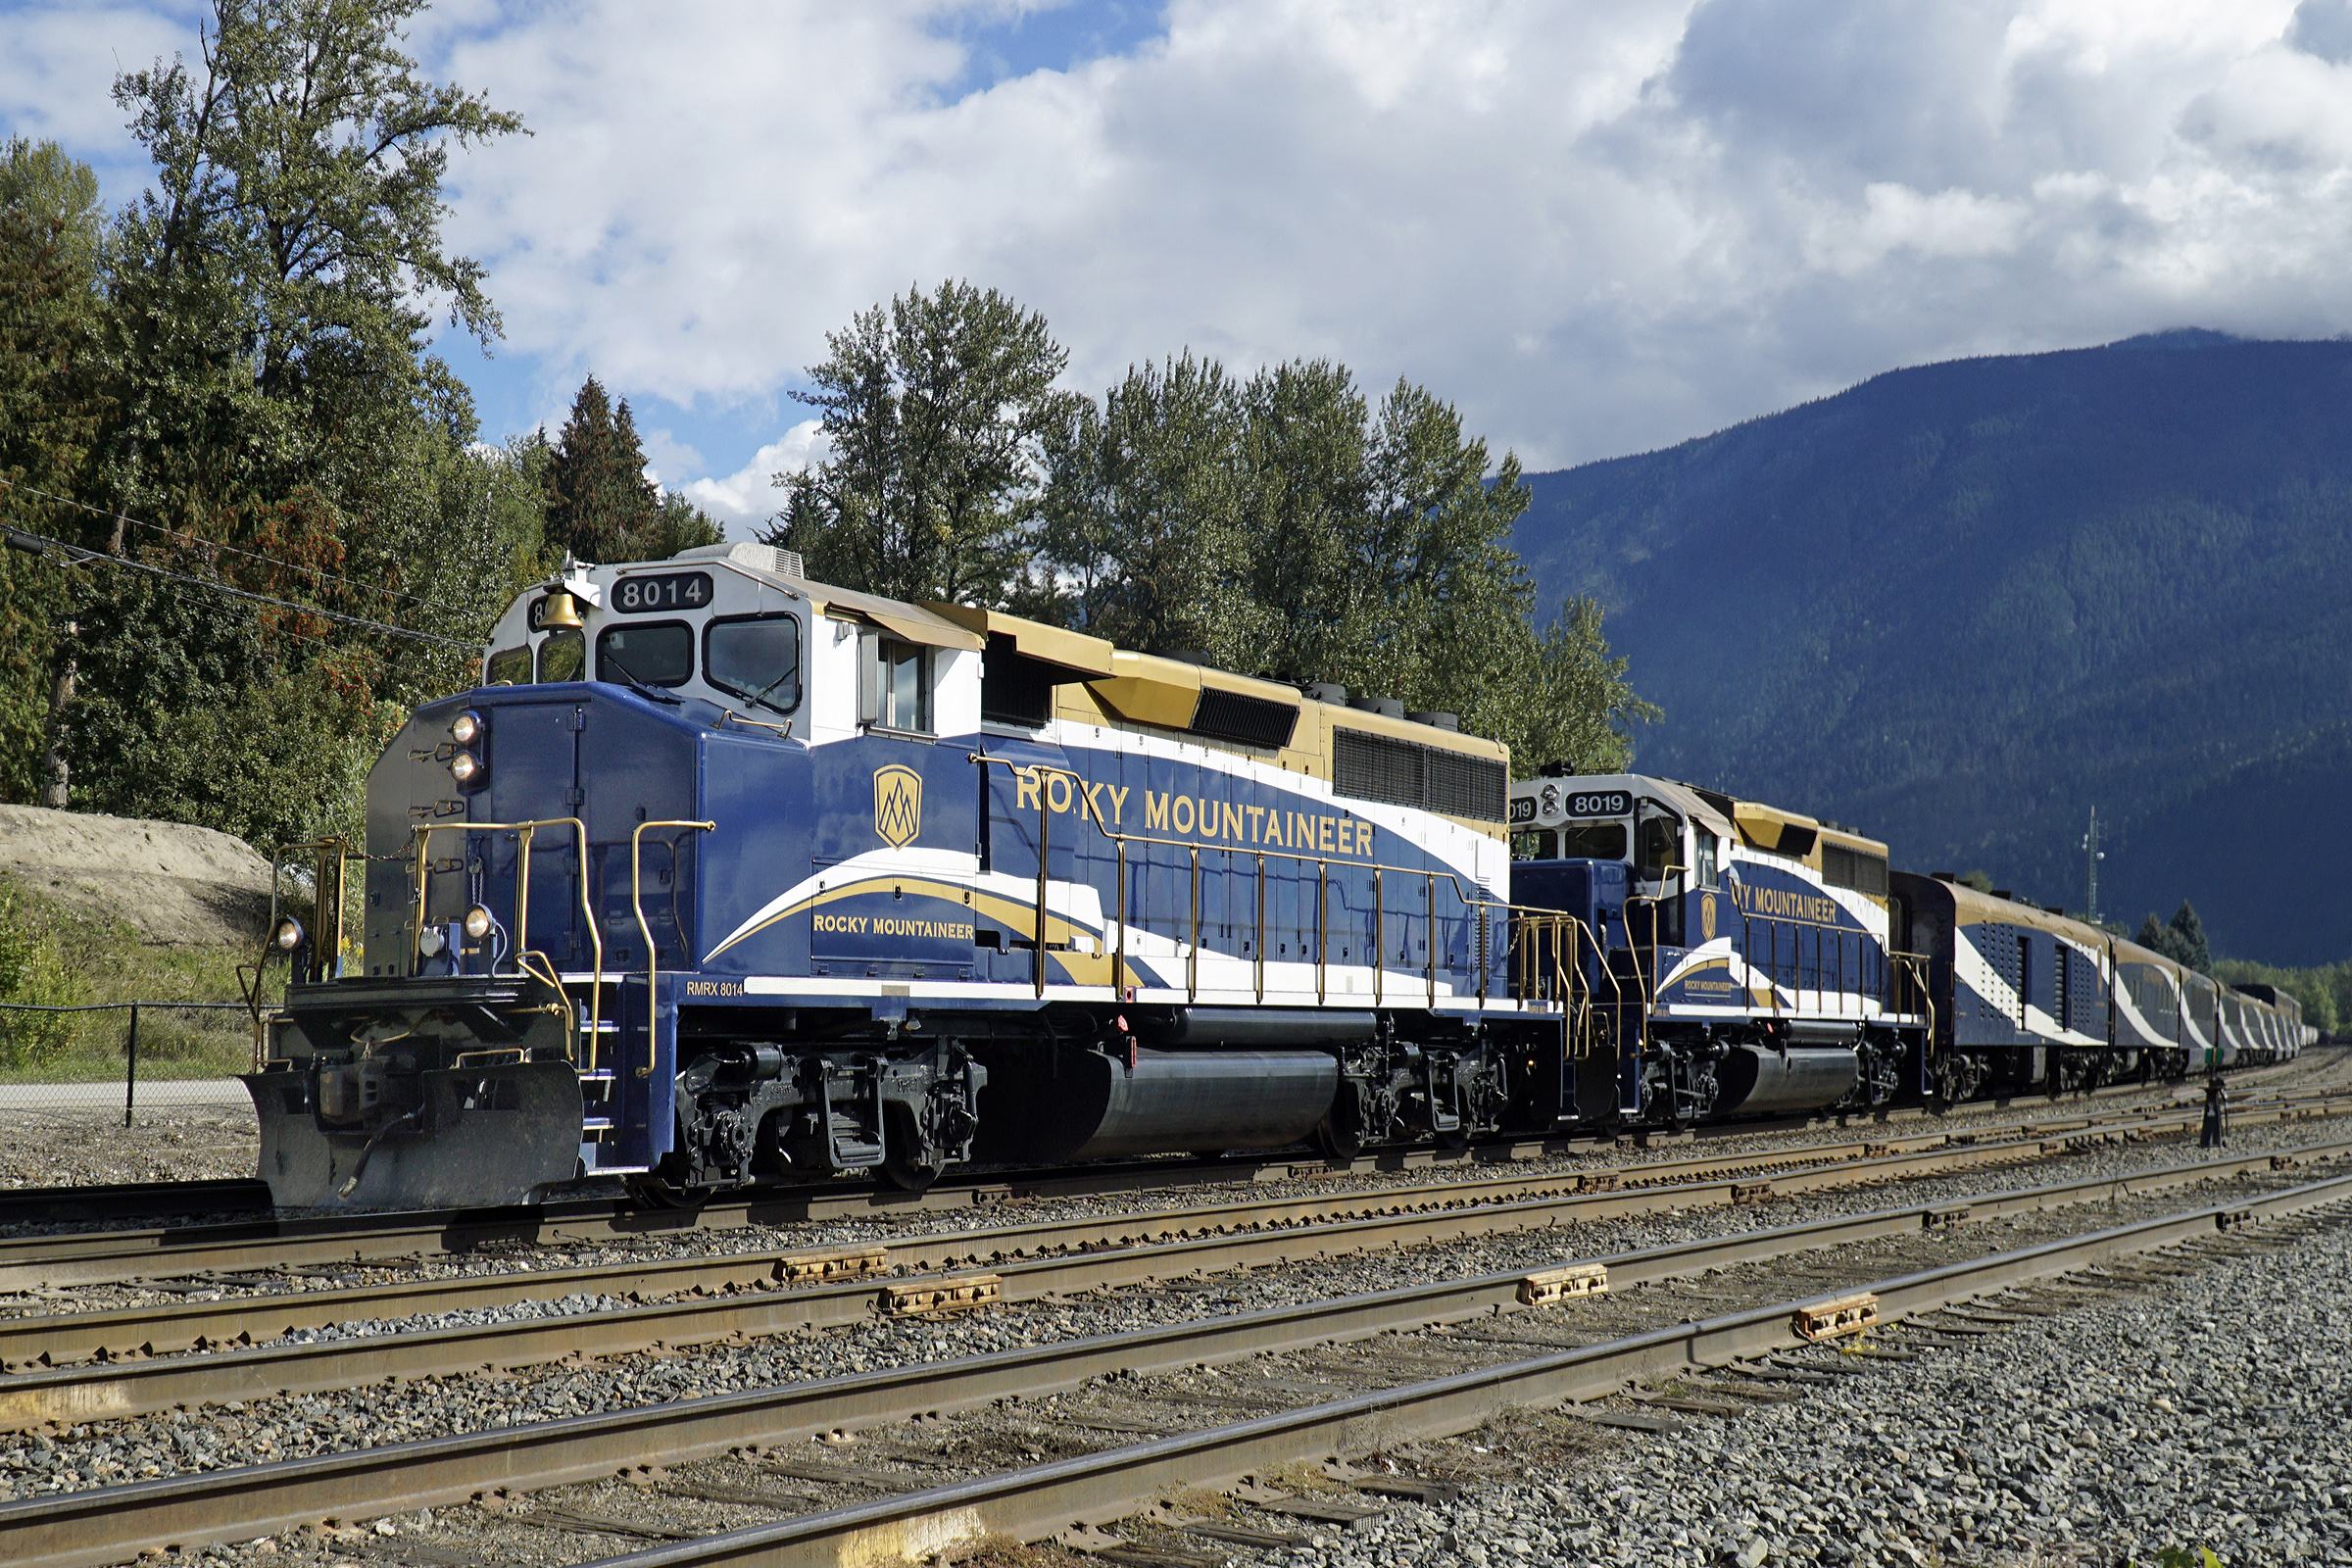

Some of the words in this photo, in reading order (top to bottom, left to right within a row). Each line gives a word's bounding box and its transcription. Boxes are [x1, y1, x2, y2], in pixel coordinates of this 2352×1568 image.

[622, 578, 702, 607] 8014
[1015, 766, 1129, 825] ROKY
[1145, 790, 1372, 858] MOUNTAINEER
[1509, 801, 1532, 819] 019
[1574, 794, 1624, 813] 8019
[1754, 887, 1838, 923] MOUNTAINEER
[813, 914, 868, 933] ROCKY
[872, 917, 974, 940] MOUNTAINEER
[687, 981, 718, 996] RMRX
[720, 982, 743, 997] 8014
[1685, 980, 1700, 991] ROCKY
